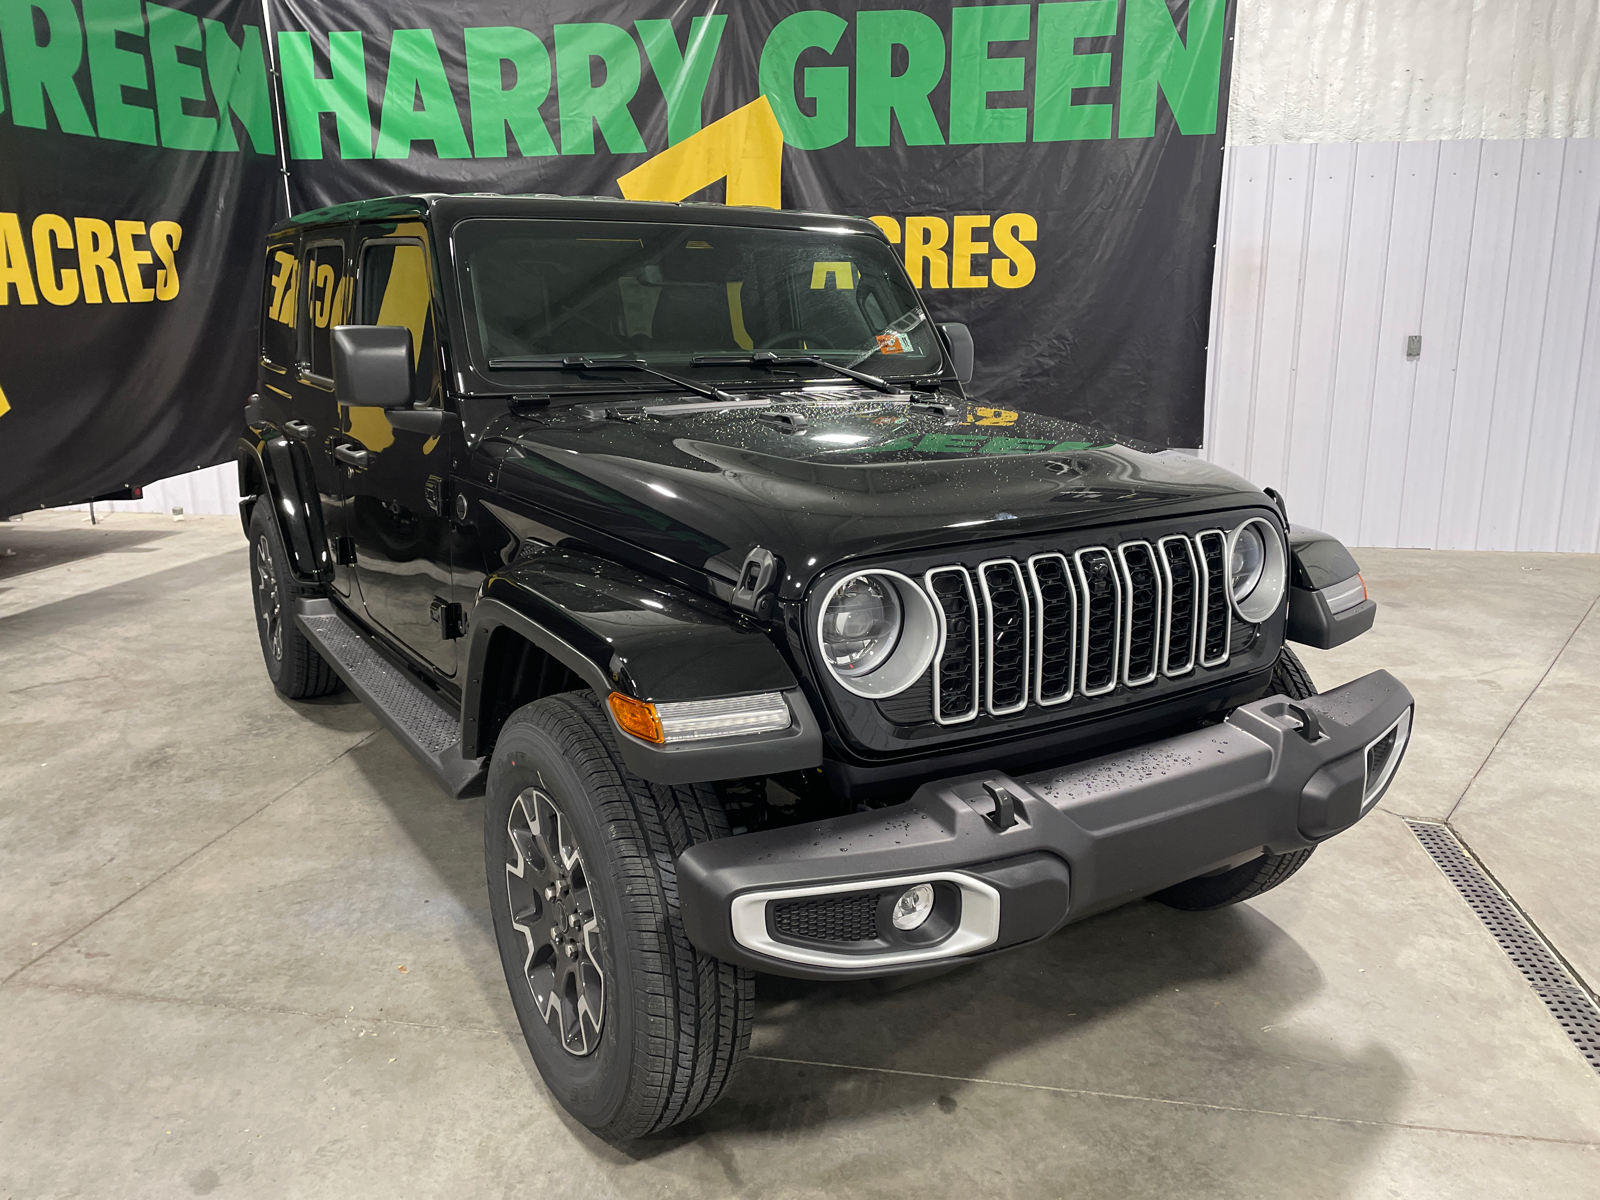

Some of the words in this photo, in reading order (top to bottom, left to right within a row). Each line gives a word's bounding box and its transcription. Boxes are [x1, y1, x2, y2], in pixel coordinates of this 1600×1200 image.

[0, 0, 276, 156] REEN
[278, 14, 728, 160] HARRY
[759, 0, 1226, 150] GREEN
